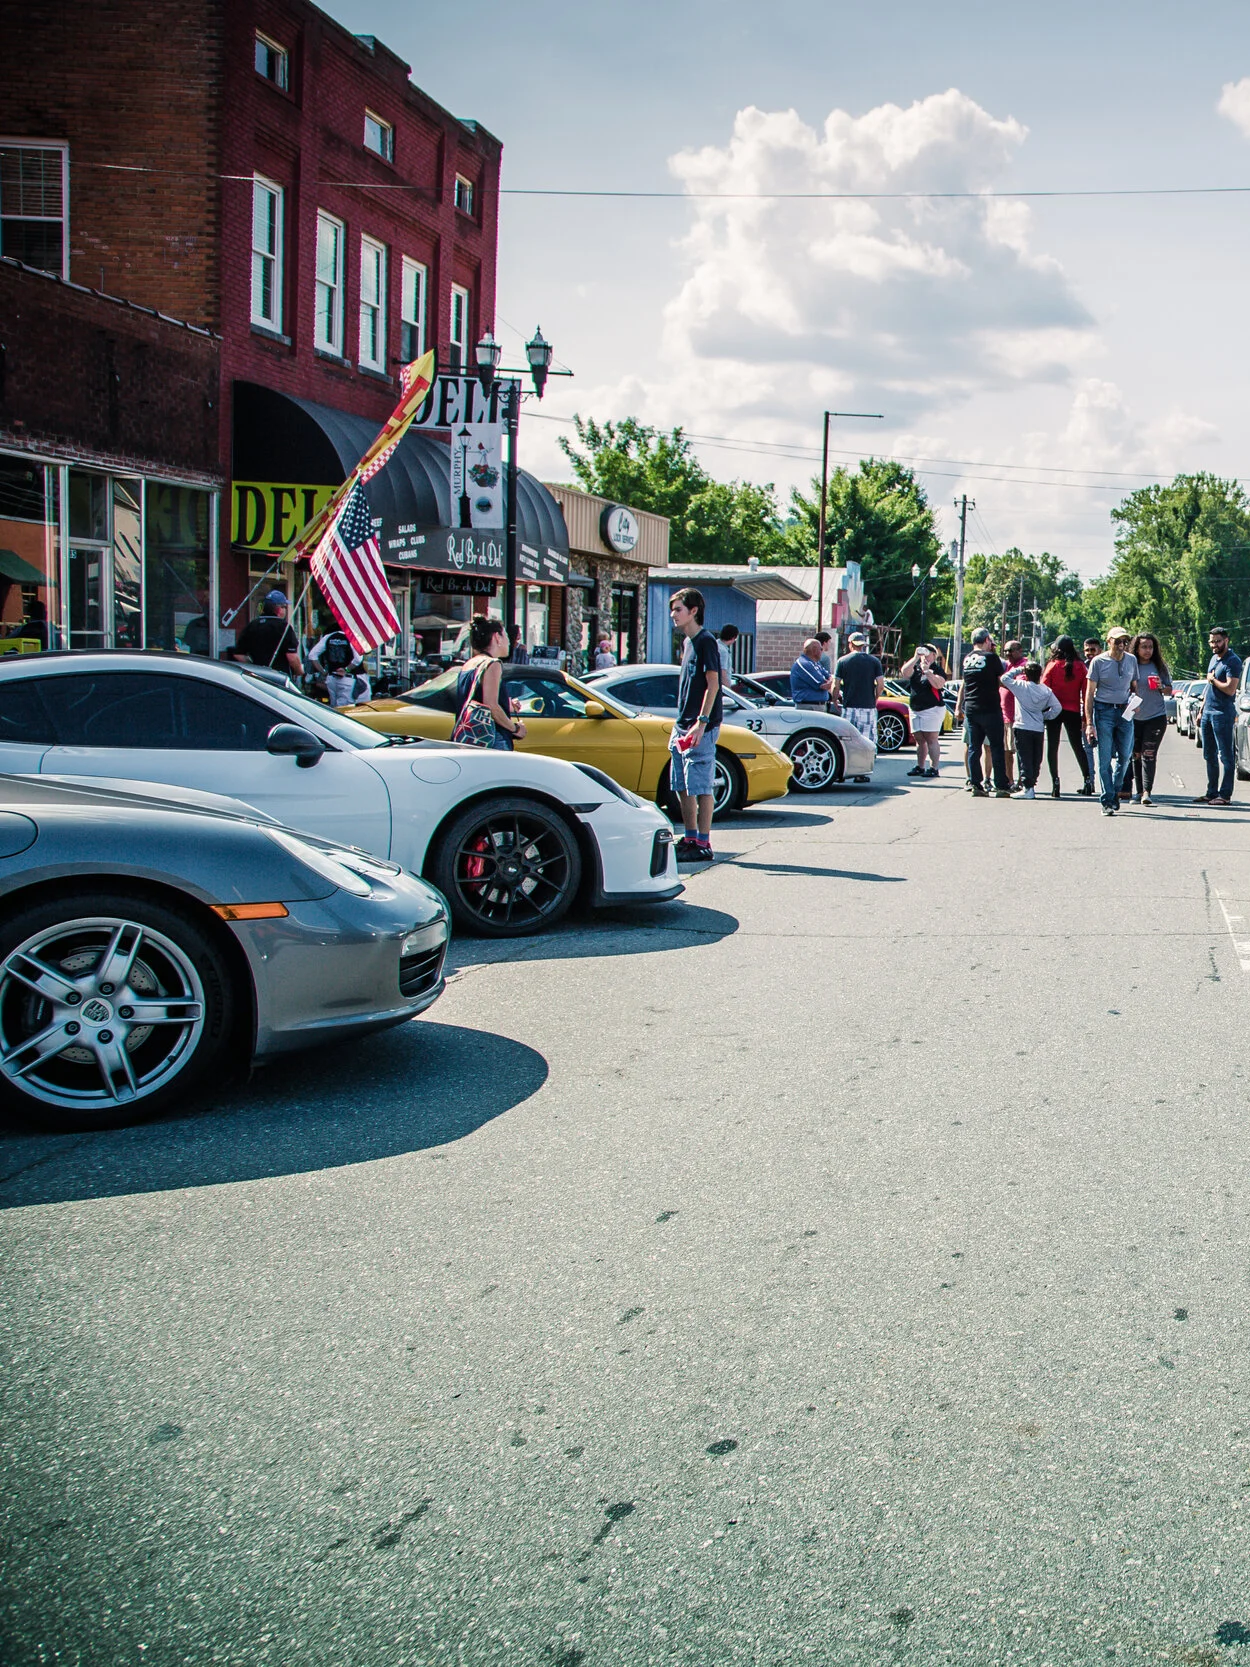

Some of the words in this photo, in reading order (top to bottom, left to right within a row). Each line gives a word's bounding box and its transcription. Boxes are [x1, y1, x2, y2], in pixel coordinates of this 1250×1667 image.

[234, 485, 338, 548] DEL
[398, 524, 416, 534] SALADS
[388, 538, 406, 549] WRAPS
[410, 535, 425, 546] CLUBS
[398, 549, 418, 560] CUBANS
[447, 533, 464, 569] Red
[425, 576, 444, 592] Red
[746, 719, 763, 732] 33
